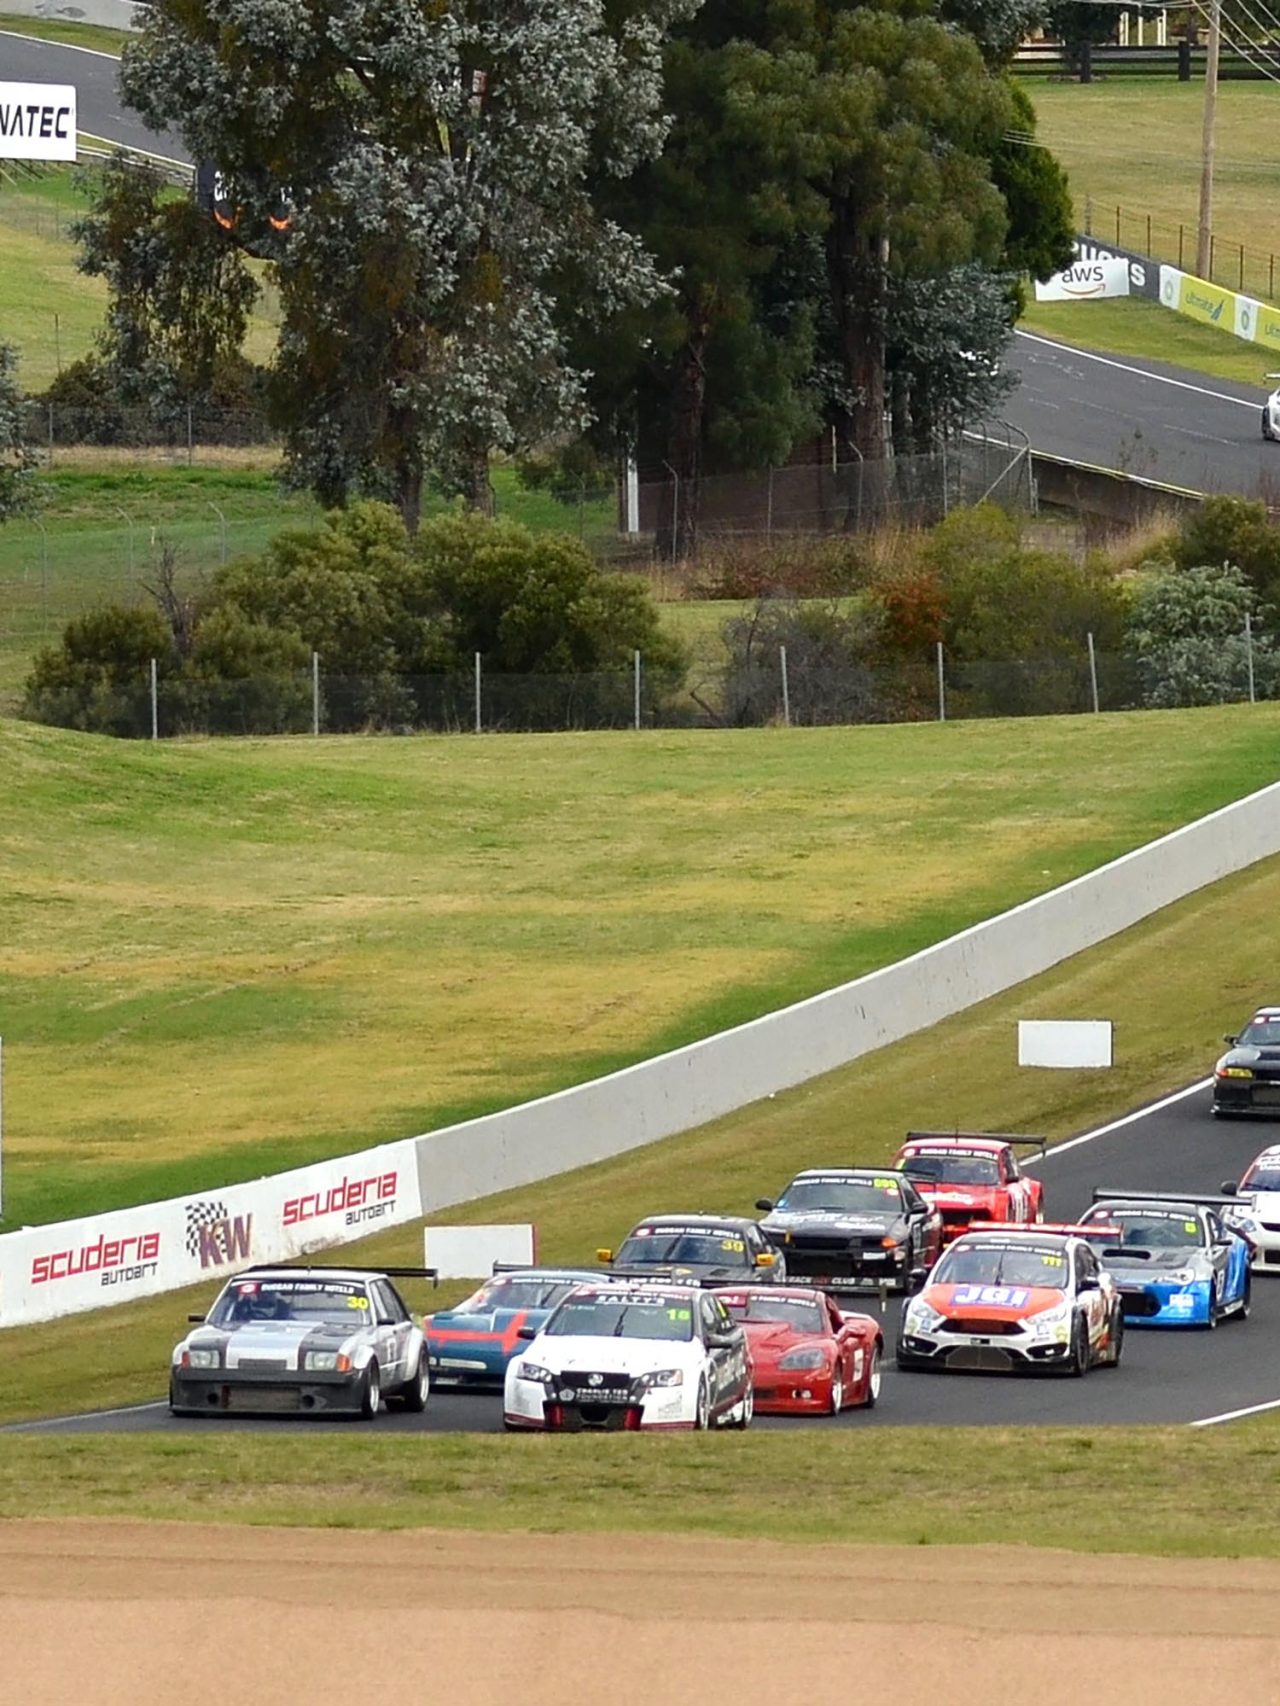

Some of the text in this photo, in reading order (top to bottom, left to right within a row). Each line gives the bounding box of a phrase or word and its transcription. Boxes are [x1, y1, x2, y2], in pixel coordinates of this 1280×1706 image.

[1062, 266, 1104, 284] aws
[282, 1171, 397, 1227] scuderia
[346, 1200, 396, 1226] autoart
[199, 1213, 254, 1269] KW
[31, 1232, 160, 1285] scuderia
[101, 1262, 158, 1287] autoart
[294, 1283, 323, 1292] FAMILY
[346, 1296, 369, 1310] 30
